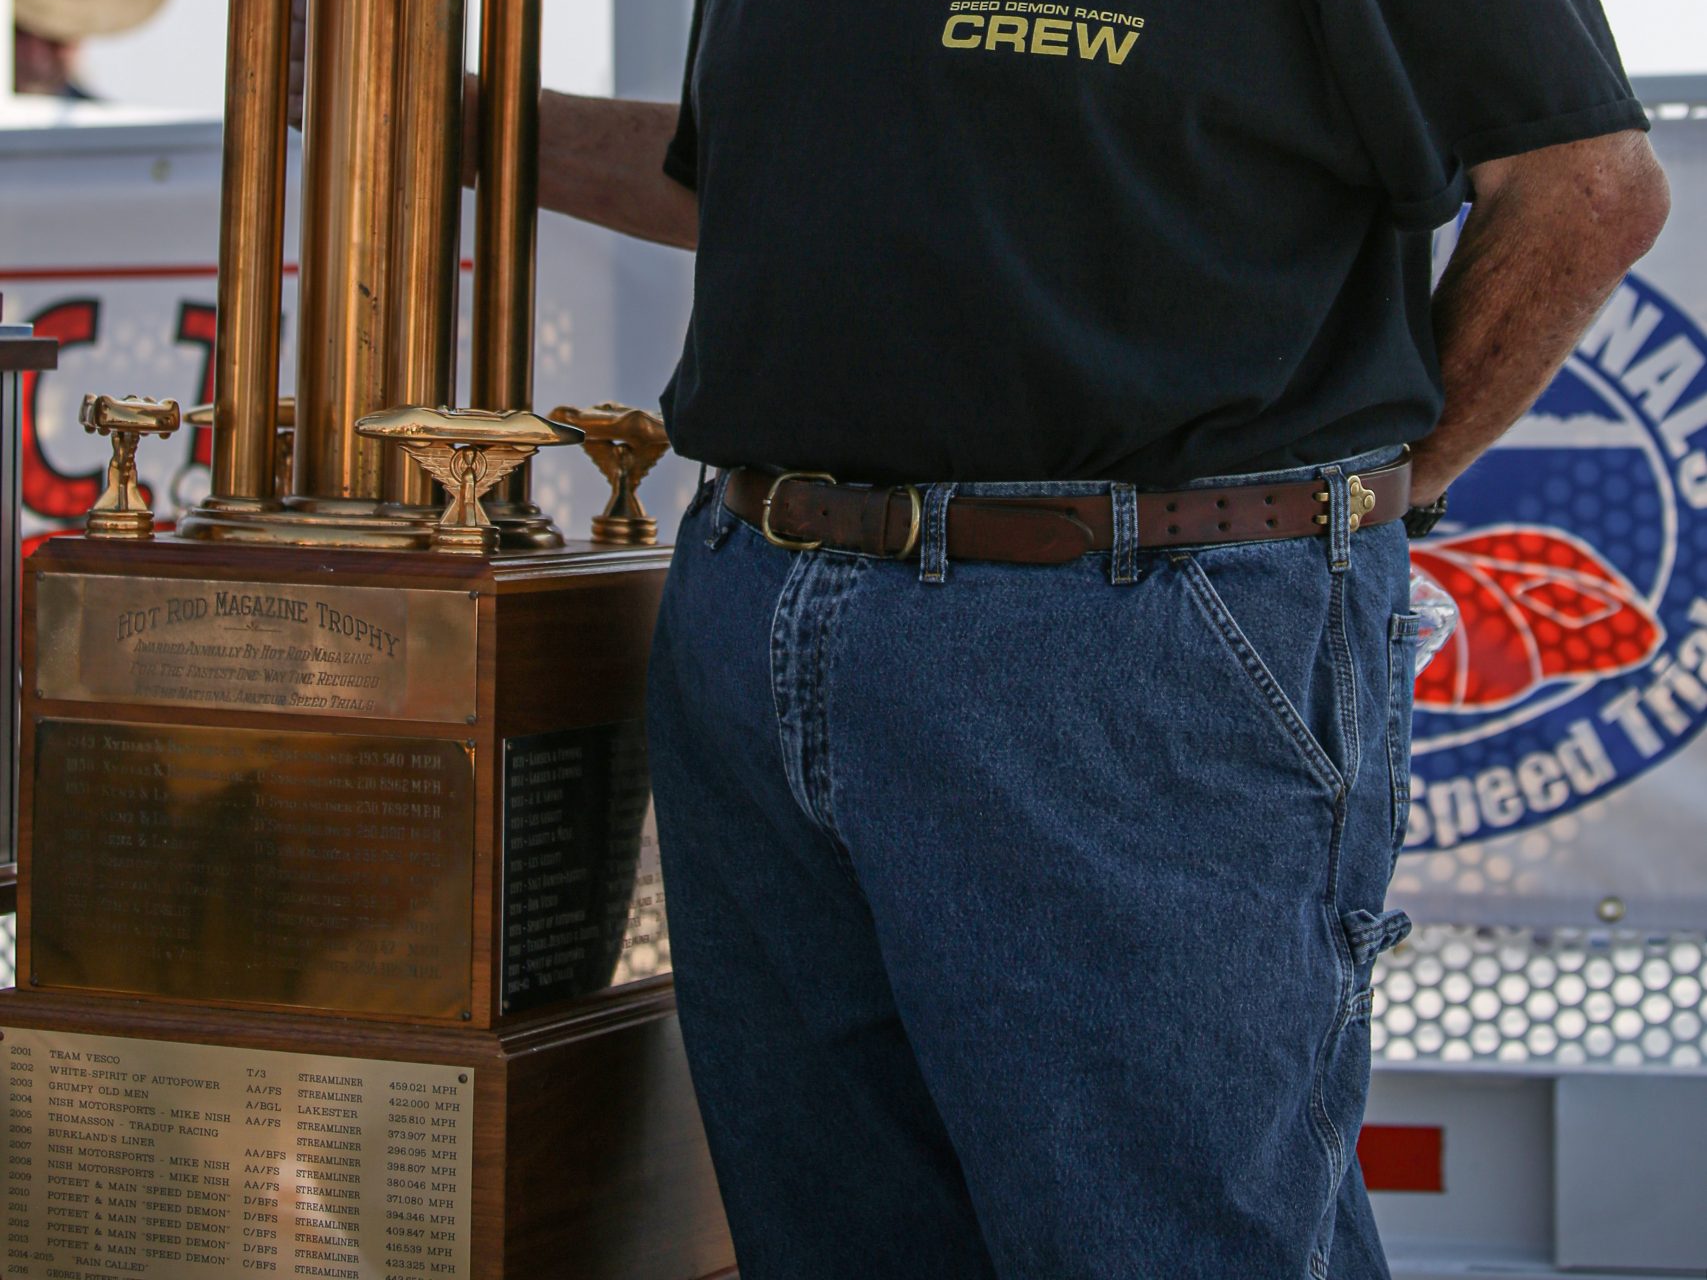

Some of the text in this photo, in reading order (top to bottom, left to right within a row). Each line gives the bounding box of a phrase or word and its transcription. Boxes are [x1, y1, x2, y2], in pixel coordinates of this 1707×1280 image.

[950, 1, 1145, 29] SPEED DEMON RACING
[941, 14, 1141, 65] CREW
[116, 591, 401, 658] HOT ROD MAGAZINE TROPHY
[260, 645, 286, 660] HOT
[311, 647, 373, 665] MAGAZINE
[1601, 598, 1707, 759] Tria
[289, 692, 327, 708] SPEED
[330, 695, 375, 712] TRIALS
[316, 672, 380, 689] RECORDED
[1402, 719, 1617, 848] Speed
[49, 1050, 80, 1061] TEAM
[86, 1053, 120, 1065] VESCO
[246, 1068, 266, 1078] T/3
[298, 1073, 363, 1087] STREAMLINER
[432, 1085, 457, 1096] MPH
[132, 1074, 147, 1083] OF
[151, 1075, 220, 1090] AUTOPOWER
[246, 1084, 282, 1096] AA/FS
[297, 1089, 363, 1103] STREAMLINER
[435, 1102, 460, 1112] MPH
[48, 1081, 94, 1093] GRUMPY
[98, 1086, 120, 1096] OLD
[124, 1089, 149, 1099] MEN
[245, 1100, 282, 1112] A/BGL
[298, 1105, 358, 1119] LAKESTER
[430, 1117, 456, 1128] MPH
[48, 1097, 74, 1107] NISH
[78, 1100, 156, 1115] MOTORSPORTS
[170, 1109, 200, 1120] MIKE
[204, 1112, 231, 1123] NISH
[245, 1116, 281, 1128] AA/FS
[296, 1121, 362, 1135] STREAMLINER
[431, 1134, 457, 1144] MPH
[48, 1113, 114, 1127] THOMASSON
[128, 1121, 174, 1133] TRADUP
[178, 1126, 219, 1138] RACING
[296, 1137, 362, 1151] STREAMLINER
[431, 1150, 457, 1160] MPH
[121, 1136, 155, 1147] LINER
[244, 1148, 286, 1160] AA/BFS
[296, 1153, 361, 1167] STREAMLINER
[431, 1166, 456, 1176] MPH
[48, 1144, 73, 1154] NISH
[78, 1147, 155, 1162] MOTORSPORTS
[169, 1157, 199, 1167] MIKE
[204, 1160, 230, 1170] NISH
[244, 1164, 280, 1176] AA/FS
[296, 1169, 361, 1183] STREAMLINER
[431, 1182, 456, 1193] MPH
[48, 1160, 73, 1170] NISH
[78, 1163, 154, 1178] MOTORSPORTS
[169, 1173, 199, 1183] MIKE
[203, 1176, 230, 1186] NISH
[244, 1180, 280, 1192] AA/FS
[295, 1185, 361, 1199] STREAMLINER
[428, 1198, 454, 1209] MPH
[47, 1175, 90, 1187] POTEET
[108, 1182, 137, 1193] MAIN
[244, 1196, 278, 1207] D/BFS
[295, 1201, 360, 1215] STREAMLINER
[430, 1215, 455, 1225] MPH
[47, 1191, 90, 1203] POTEET
[108, 1198, 137, 1208] MAIN
[243, 1212, 278, 1223] D/BFS
[295, 1217, 360, 1231] STREAMLINER
[430, 1231, 456, 1241] MPH
[47, 1207, 90, 1218] POTEET
[108, 1213, 137, 1224] MAIN
[243, 1228, 277, 1239] C/BFS
[294, 1233, 360, 1247] STREAMLINER
[427, 1247, 452, 1257] MPH
[47, 1222, 89, 1234] POTEET
[107, 1229, 136, 1240] MAIN
[243, 1244, 278, 1255] D/BFS
[294, 1249, 360, 1263] STREAMLINER
[430, 1263, 456, 1273] MPH
[47, 1238, 89, 1250] POTEET
[107, 1245, 136, 1255] MAIN
[242, 1259, 276, 1270] C/BFS
[294, 1265, 359, 1279] STREAMLINER
